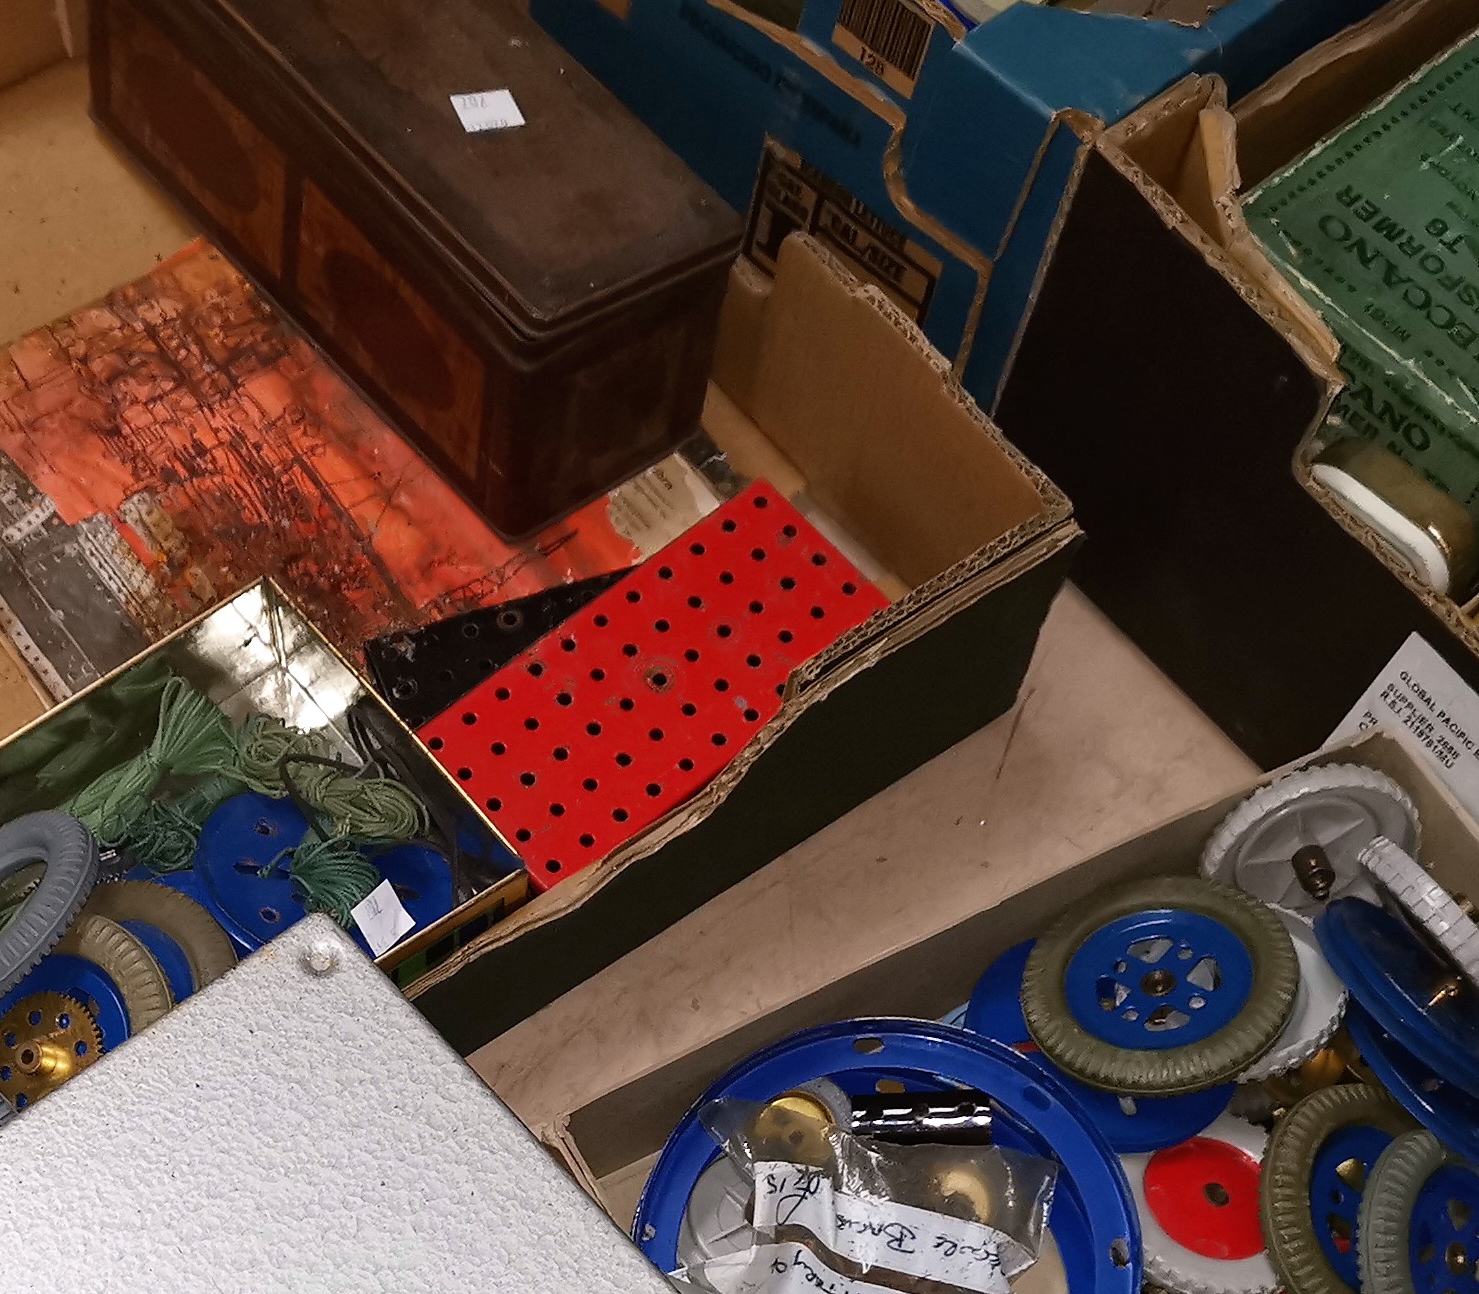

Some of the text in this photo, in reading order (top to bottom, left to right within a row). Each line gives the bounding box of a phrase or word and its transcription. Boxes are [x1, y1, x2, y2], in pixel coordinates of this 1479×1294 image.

[1335, 184, 1479, 312] SFORMER
[1425, 217, 1465, 254] T6
[1319, 215, 1479, 362] ECCANO
[1362, 710, 1379, 726] PR
[1399, 670, 1475, 751] GLOBAL PACIFIC
